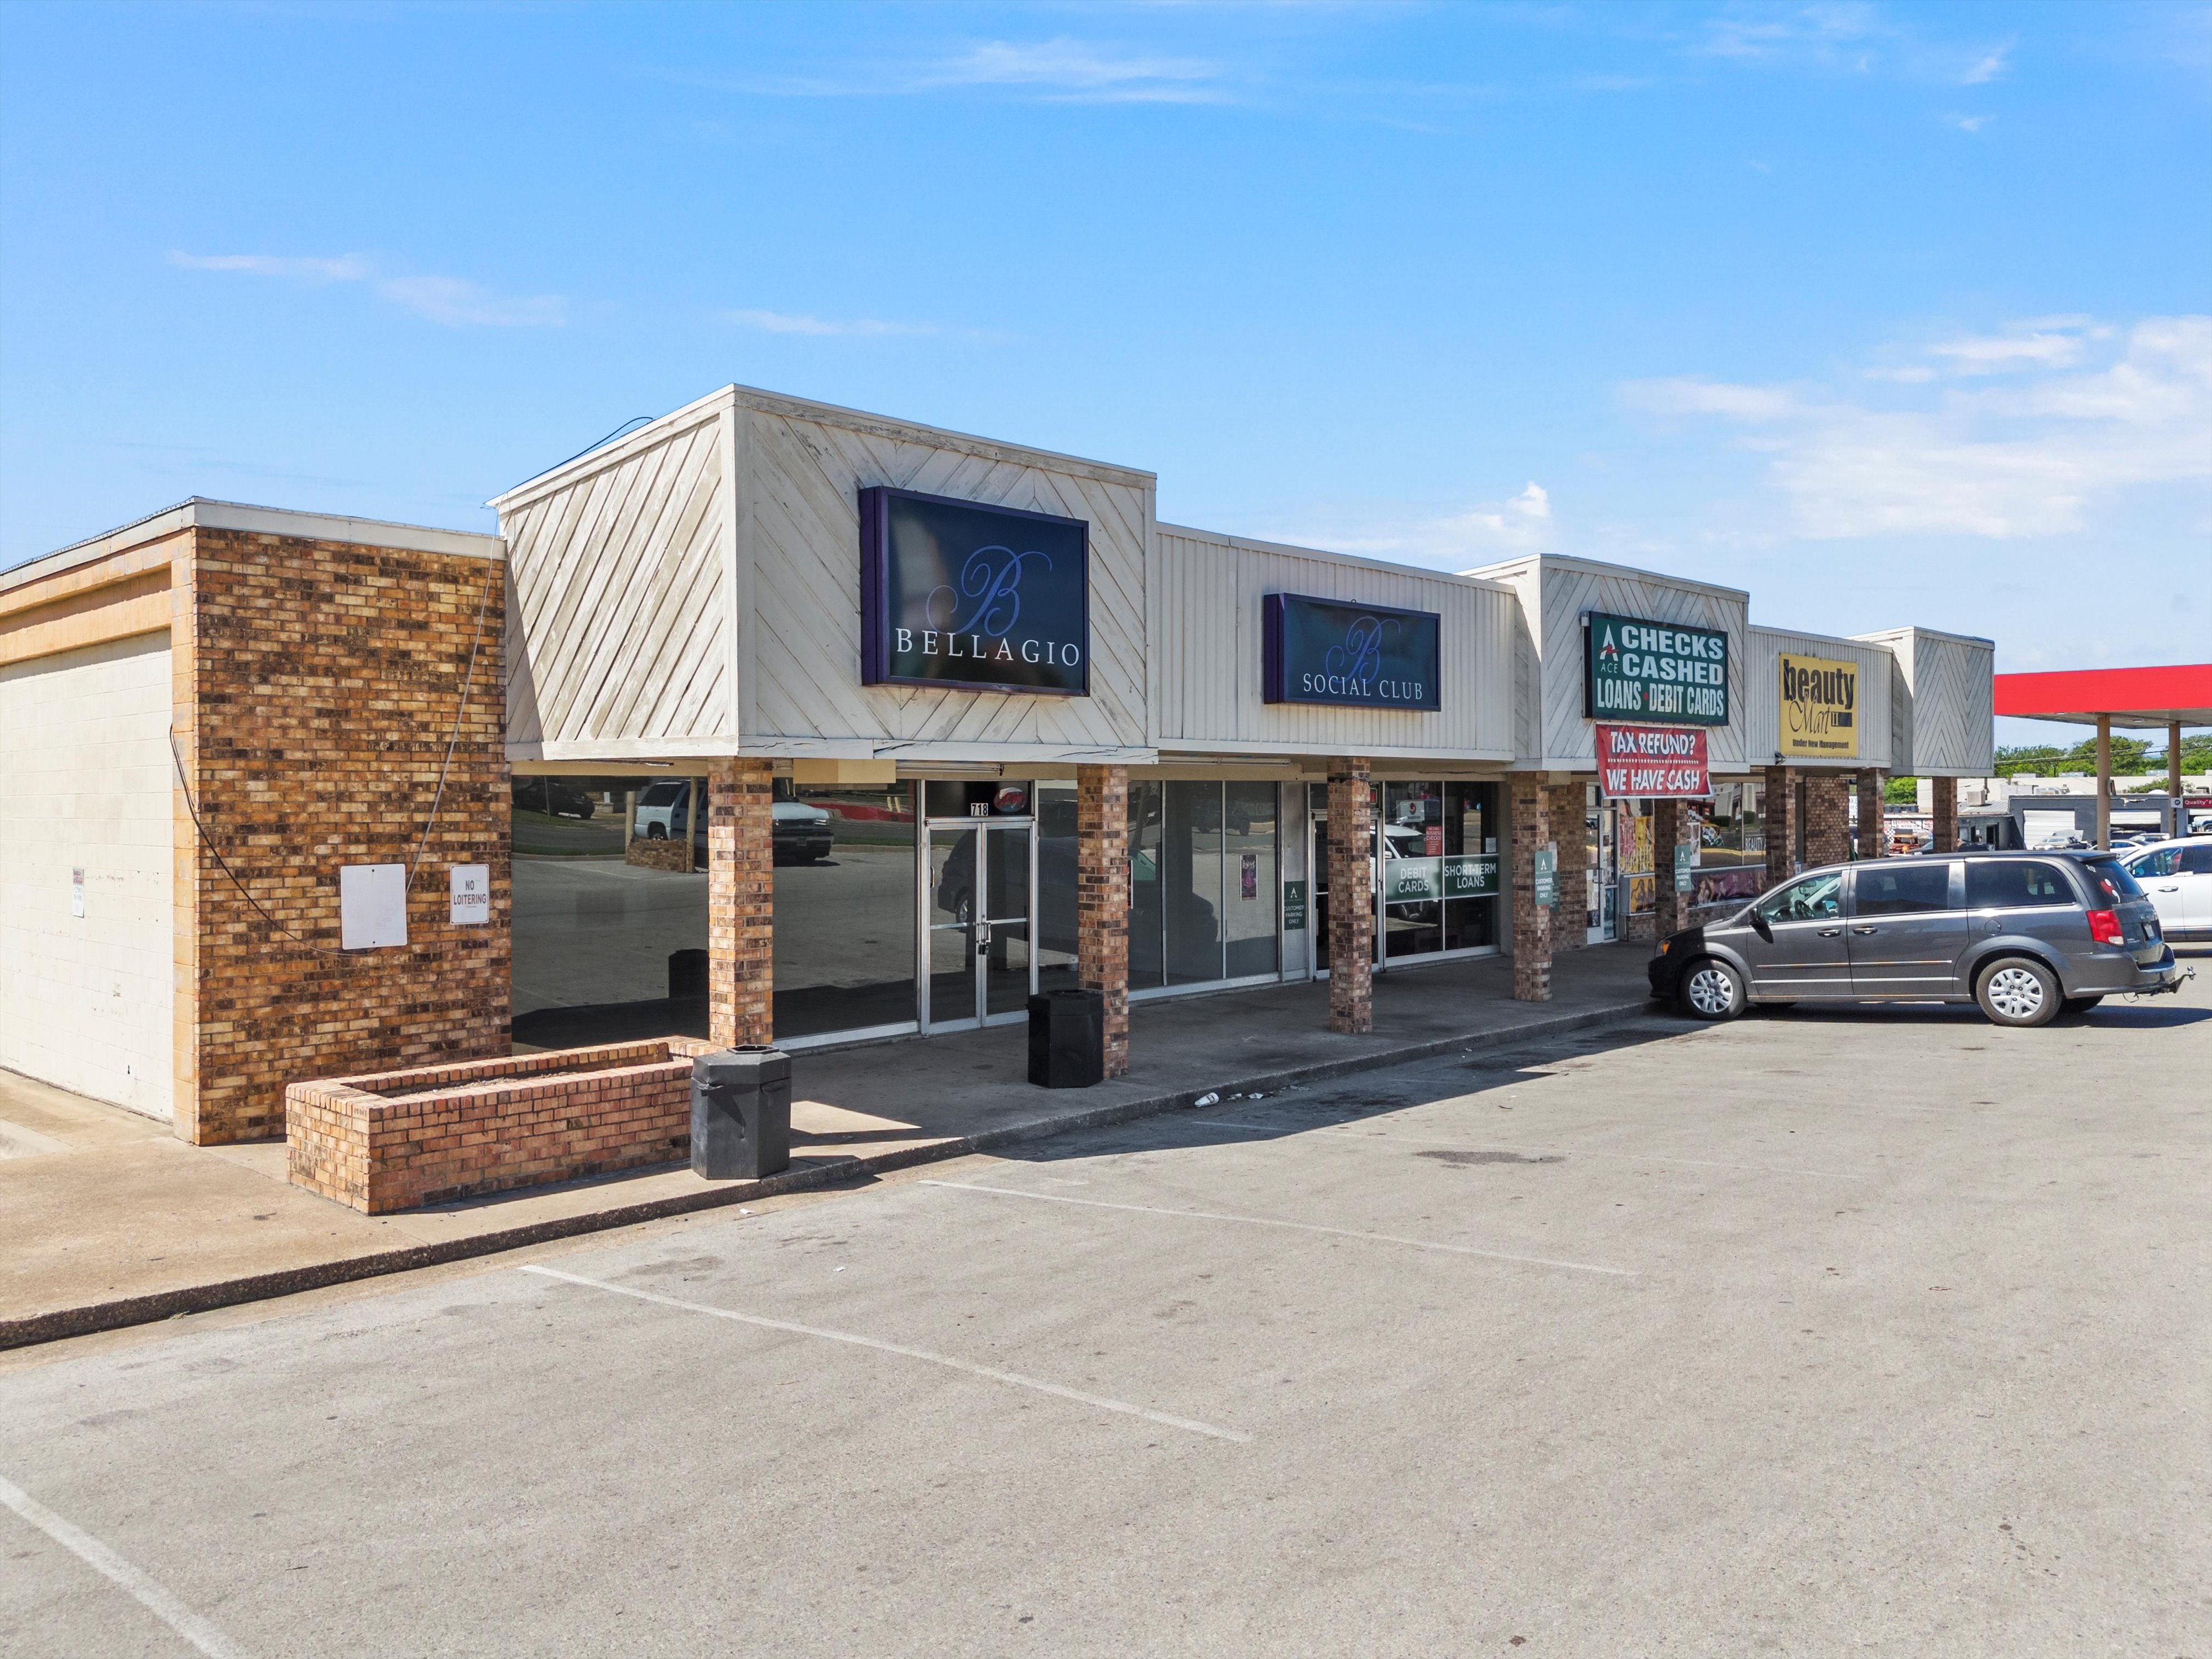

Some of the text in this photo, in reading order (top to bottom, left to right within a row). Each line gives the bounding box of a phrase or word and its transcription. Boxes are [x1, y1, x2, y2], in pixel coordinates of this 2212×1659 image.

[926, 545, 1052, 637] B
[895, 628, 1079, 666] BELLAGIO
[1326, 615, 1401, 684] B
[1621, 625, 1724, 660] CHECKS
[1600, 662, 1618, 673] ACE
[1622, 653, 1723, 685] CASHED
[1303, 673, 1422, 700] SOCIAL CLUB
[1783, 659, 1854, 710] beauty
[1597, 678, 1724, 717] LOANS DEBIT CARDS
[1789, 691, 1830, 734] Mart
[1610, 731, 1695, 755] TAX REFUND?
[1792, 739, 1849, 749] Under New Management
[1606, 769, 1700, 791] WE HAVE CASH
[972, 804, 988, 815] 718
[1745, 837, 1763, 851] BEAUTY
[1400, 867, 1427, 880] DEBIT
[1444, 863, 1496, 877] SHORT-TERM
[466, 880, 474, 891] NO
[1399, 879, 1429, 893] CARDS
[1457, 877, 1485, 889] LOANS
[453, 894, 487, 905] LOITERING
